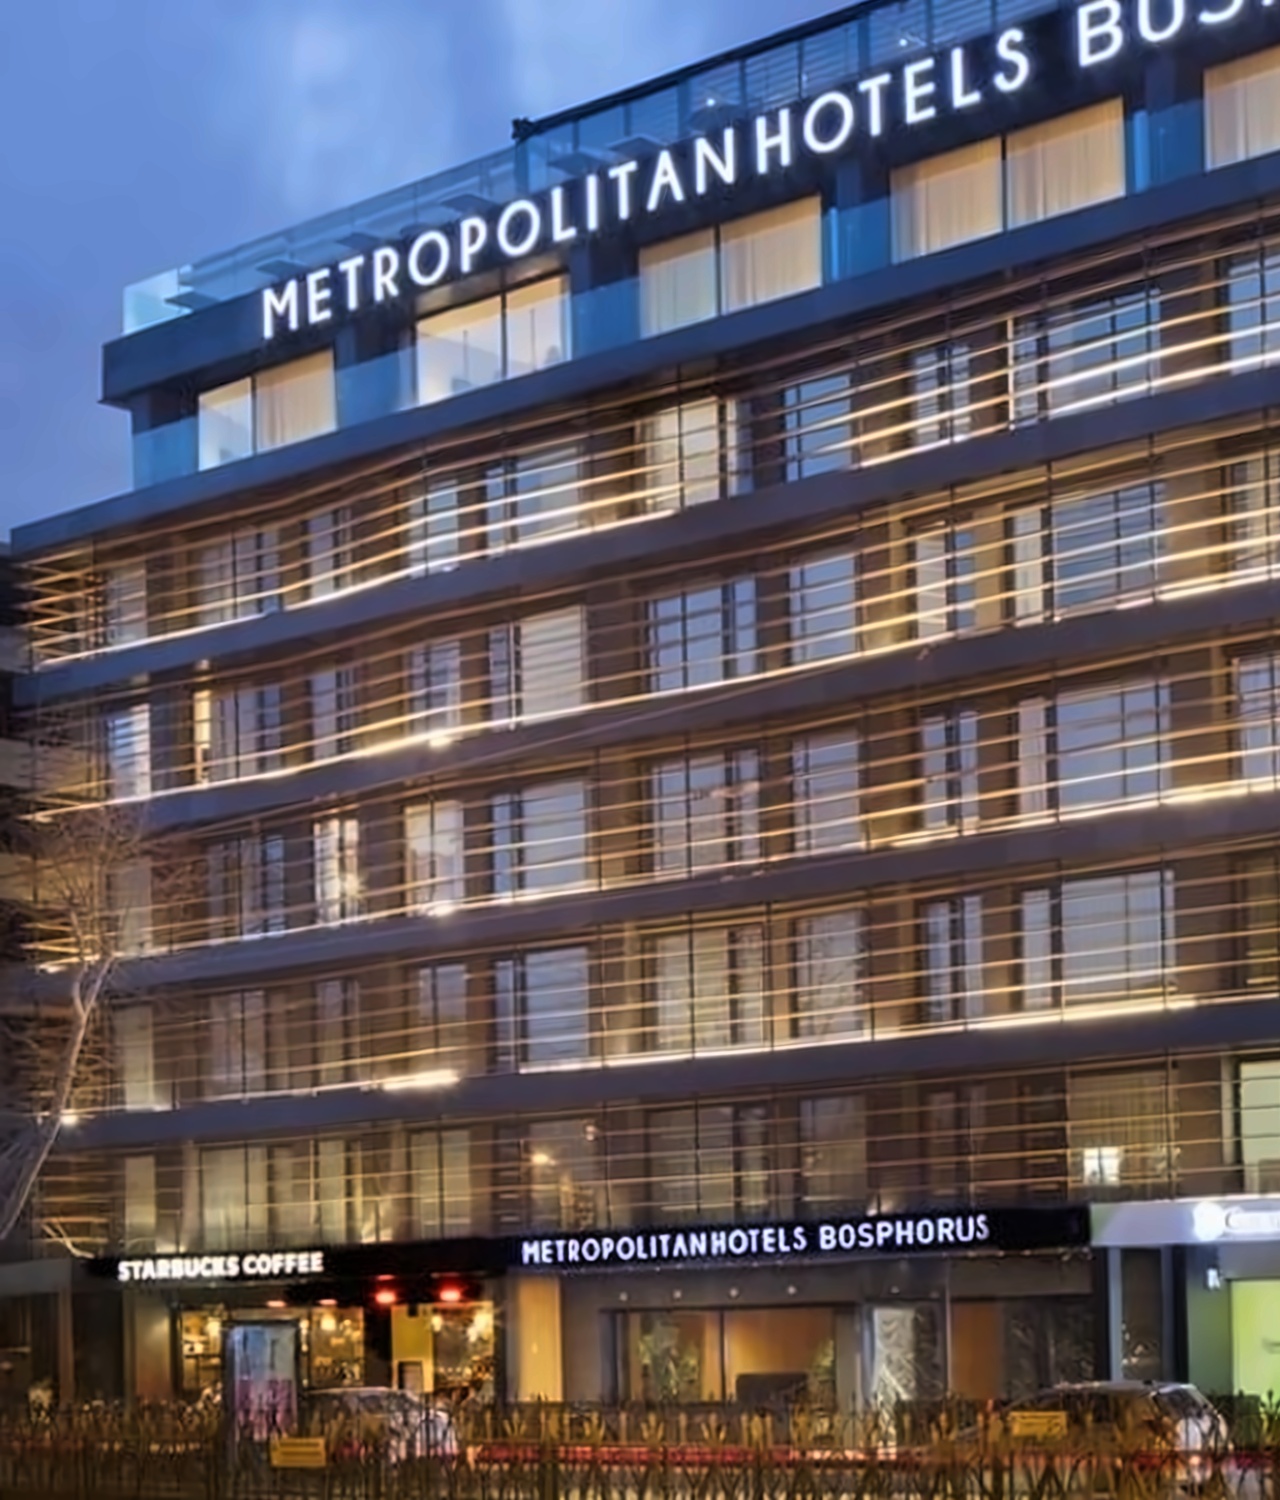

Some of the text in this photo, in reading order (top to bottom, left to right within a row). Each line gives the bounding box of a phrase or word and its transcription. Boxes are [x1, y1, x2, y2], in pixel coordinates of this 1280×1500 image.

[819, 1214, 990, 1250] BOSPHORUS
[118, 1252, 324, 1281] STARBUCKS COFFEE
